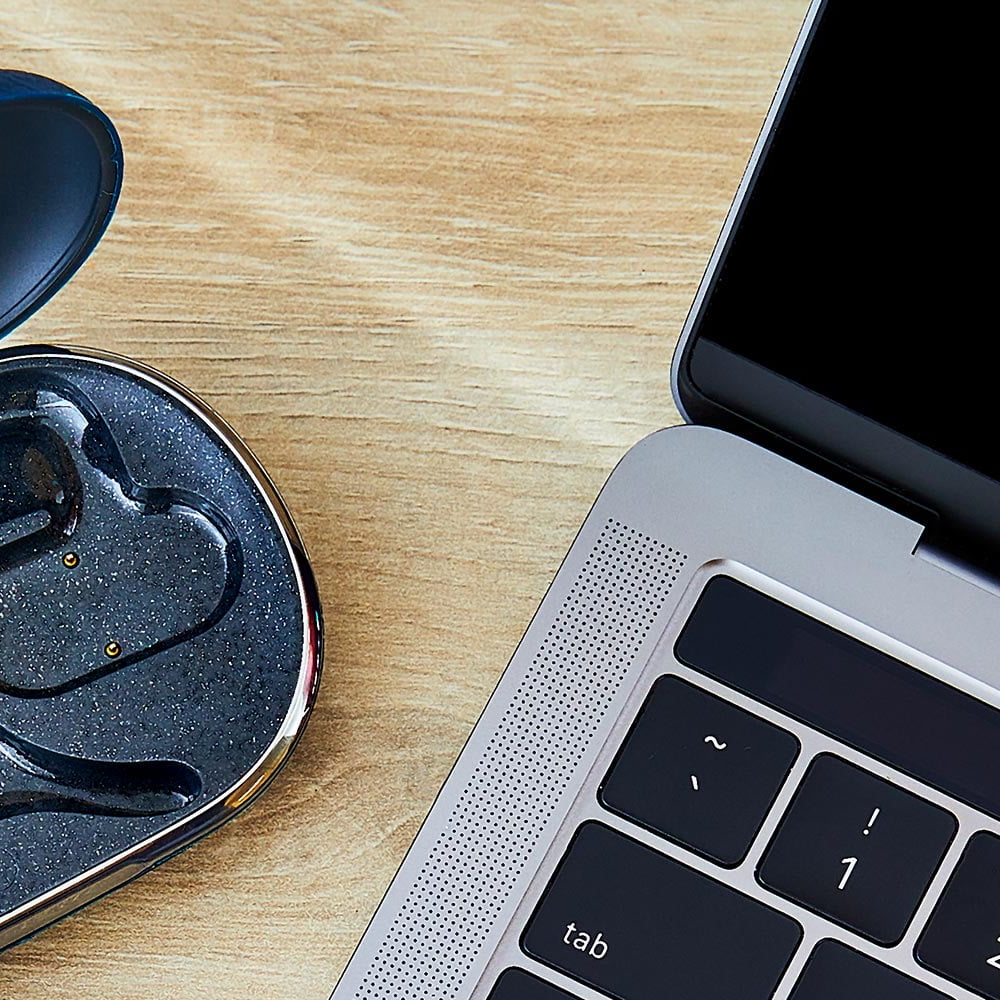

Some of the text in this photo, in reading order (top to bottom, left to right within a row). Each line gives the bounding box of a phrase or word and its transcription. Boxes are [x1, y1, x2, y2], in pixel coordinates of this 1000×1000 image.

[863, 807, 880, 836] !
[837, 857, 858, 890] 1
[563, 922, 609, 959] tab
